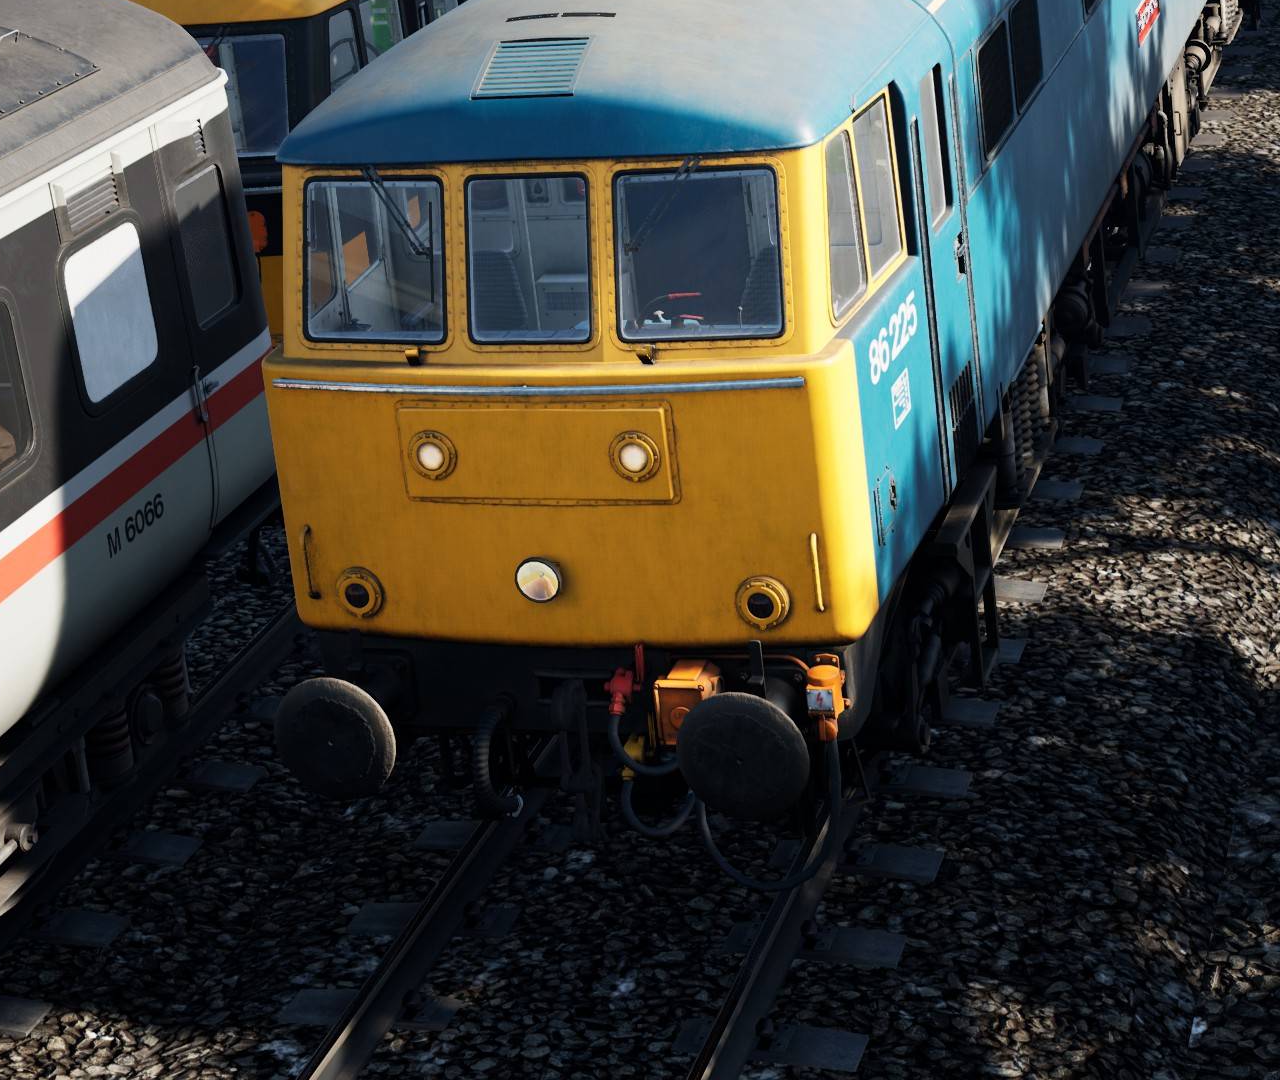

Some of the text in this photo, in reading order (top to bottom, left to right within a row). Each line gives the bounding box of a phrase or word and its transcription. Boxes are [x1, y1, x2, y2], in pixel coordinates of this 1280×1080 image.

[868, 327, 890, 385] 86
[889, 289, 918, 361] 225
[106, 493, 165, 559] M 6066
